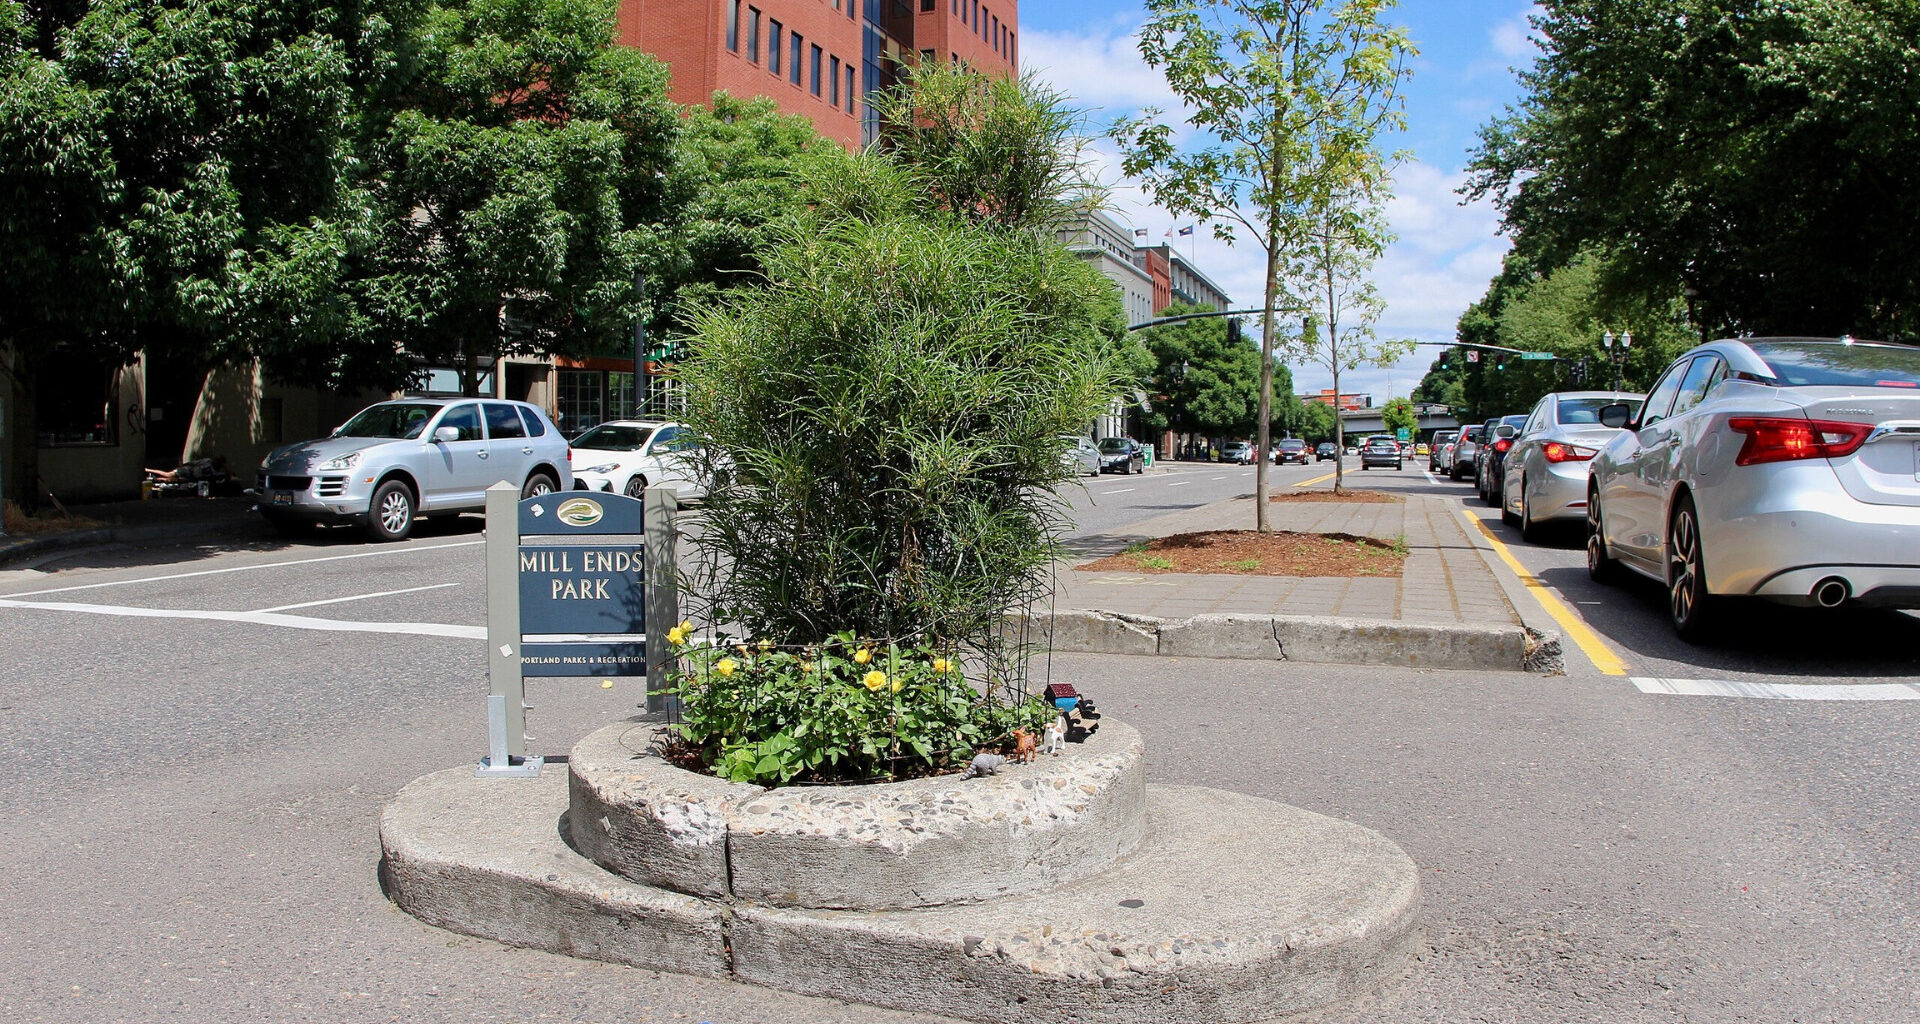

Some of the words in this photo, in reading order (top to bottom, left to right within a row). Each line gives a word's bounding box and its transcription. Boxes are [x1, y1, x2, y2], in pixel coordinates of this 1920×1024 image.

[520, 551, 573, 572] MILL
[583, 551, 643, 572] ENDS
[552, 578, 610, 600] PARK
[520, 656, 561, 664] PORTLAND
[563, 656, 586, 664] PARKS
[589, 656, 595, 664] &
[597, 656, 646, 664] RECREATION
